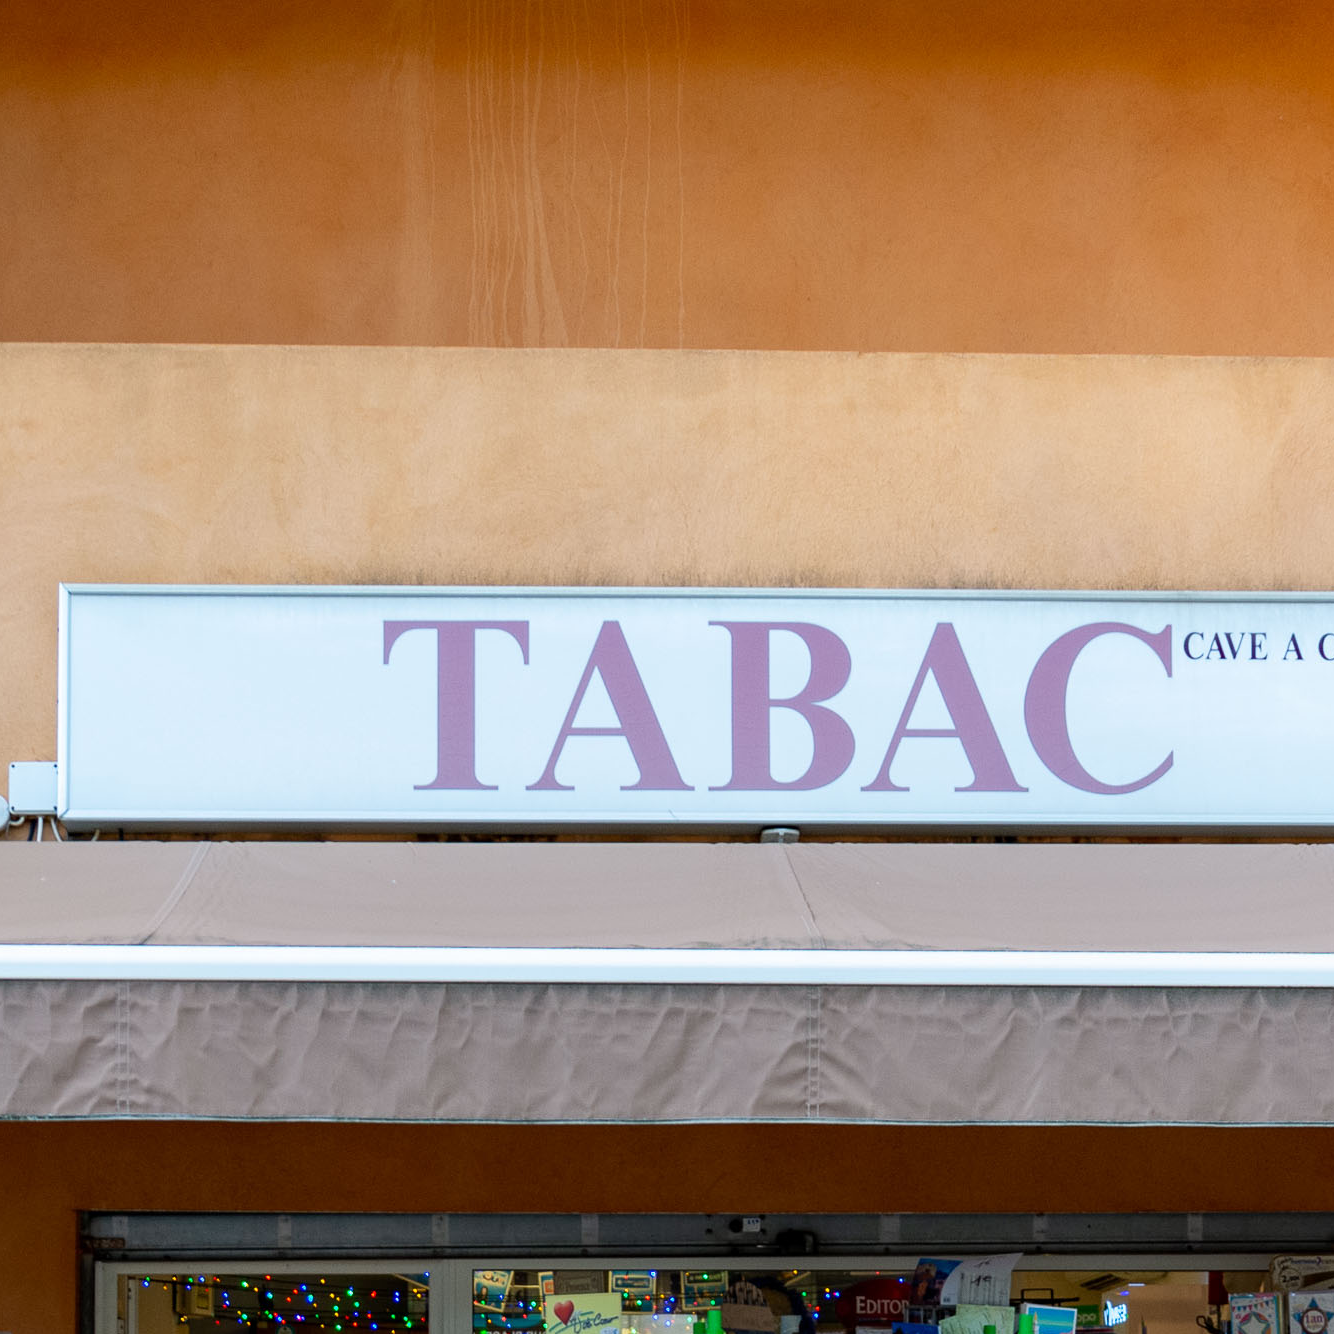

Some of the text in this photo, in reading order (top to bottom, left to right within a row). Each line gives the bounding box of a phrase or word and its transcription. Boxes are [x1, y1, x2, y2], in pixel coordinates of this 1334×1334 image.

[1183, 632, 1268, 661] CAVE
[1282, 633, 1305, 661] A
[383, 620, 1174, 796] TABAC
